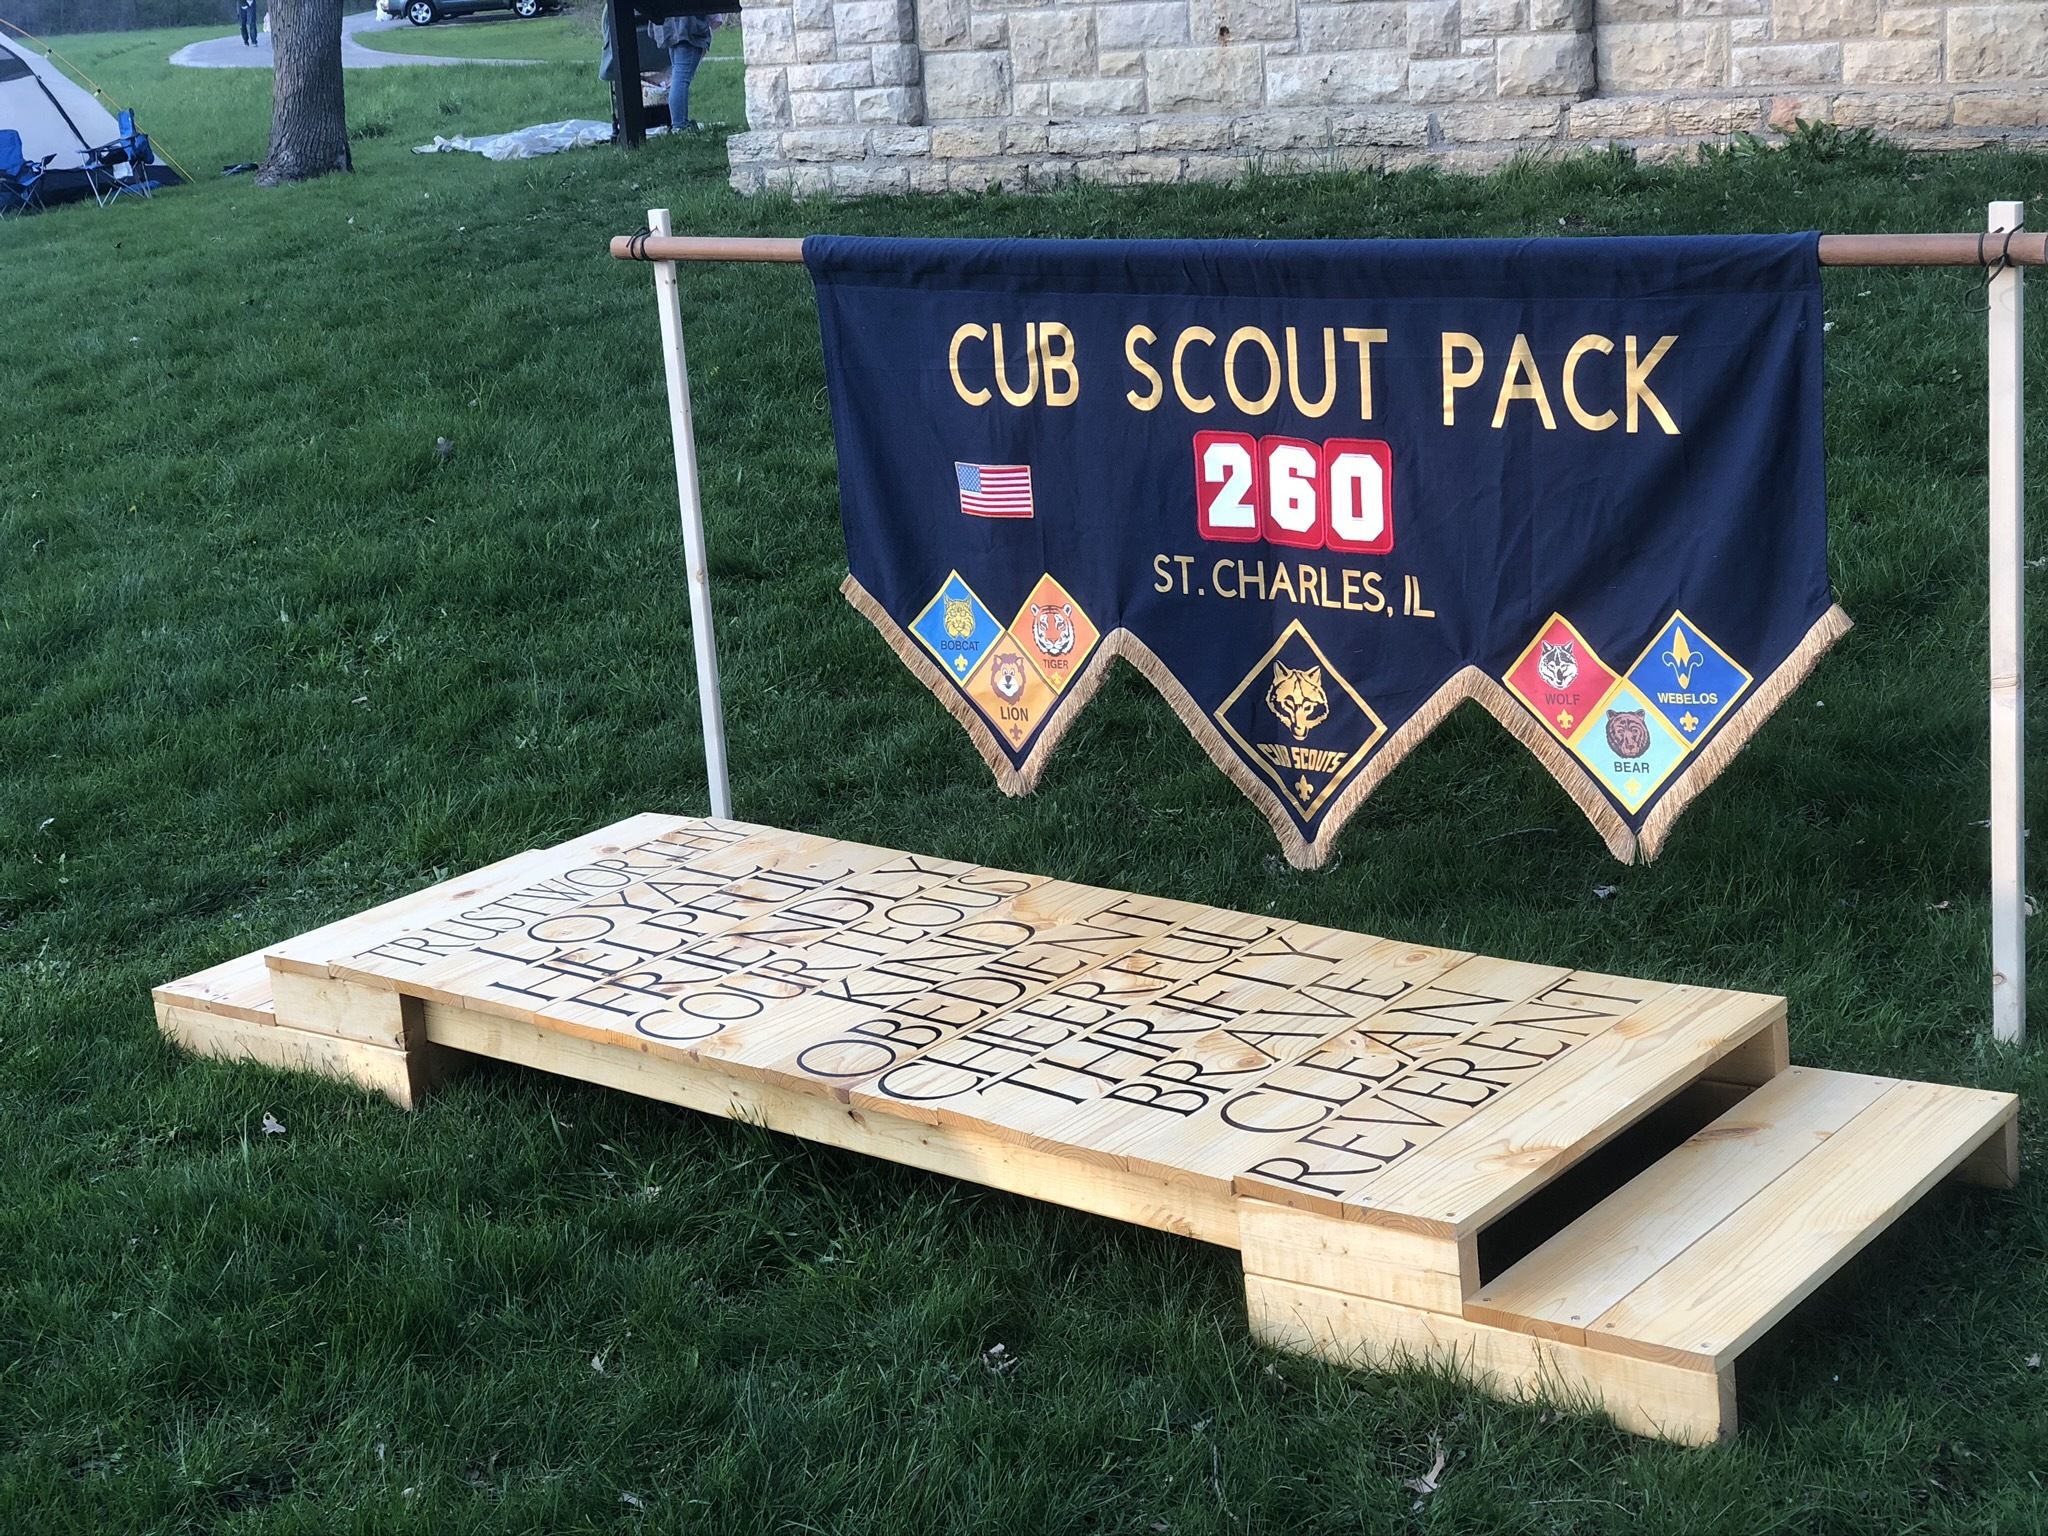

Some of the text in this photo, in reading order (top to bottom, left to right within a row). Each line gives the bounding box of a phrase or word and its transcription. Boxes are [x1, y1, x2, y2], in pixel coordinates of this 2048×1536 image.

[949, 322, 1681, 435] CUB SCOUT PACK
[1203, 442, 1387, 543] 260
[1153, 555, 1437, 619] ST. CHARLES, IL
[940, 640, 980, 651] BOBCAT
[1043, 658, 1069, 670] TIGER
[1544, 693, 1581, 705] WOLF
[1656, 692, 1719, 704] WEBELOS
[1000, 706, 1029, 722] LION
[1291, 746, 1348, 773] SCOUTS
[1613, 761, 1650, 774] BEAR
[353, 821, 753, 965] TRUSTWORTHY
[473, 863, 763, 965] LOYAL
[487, 866, 857, 1001] HELPFUL
[567, 855, 954, 1017] FRIENDLY
[634, 873, 1032, 1040] COURTEOUS
[796, 899, 1178, 1078] OBEDIENT
[817, 919, 1036, 1010] KIND
[877, 924, 1278, 1101] CHEERFUL
[978, 935, 1345, 1105] THRIFTY
[1111, 971, 1413, 1118] BRAVE
[1220, 984, 1513, 1133] CLEAN
[1246, 977, 1642, 1197] REVERENT
